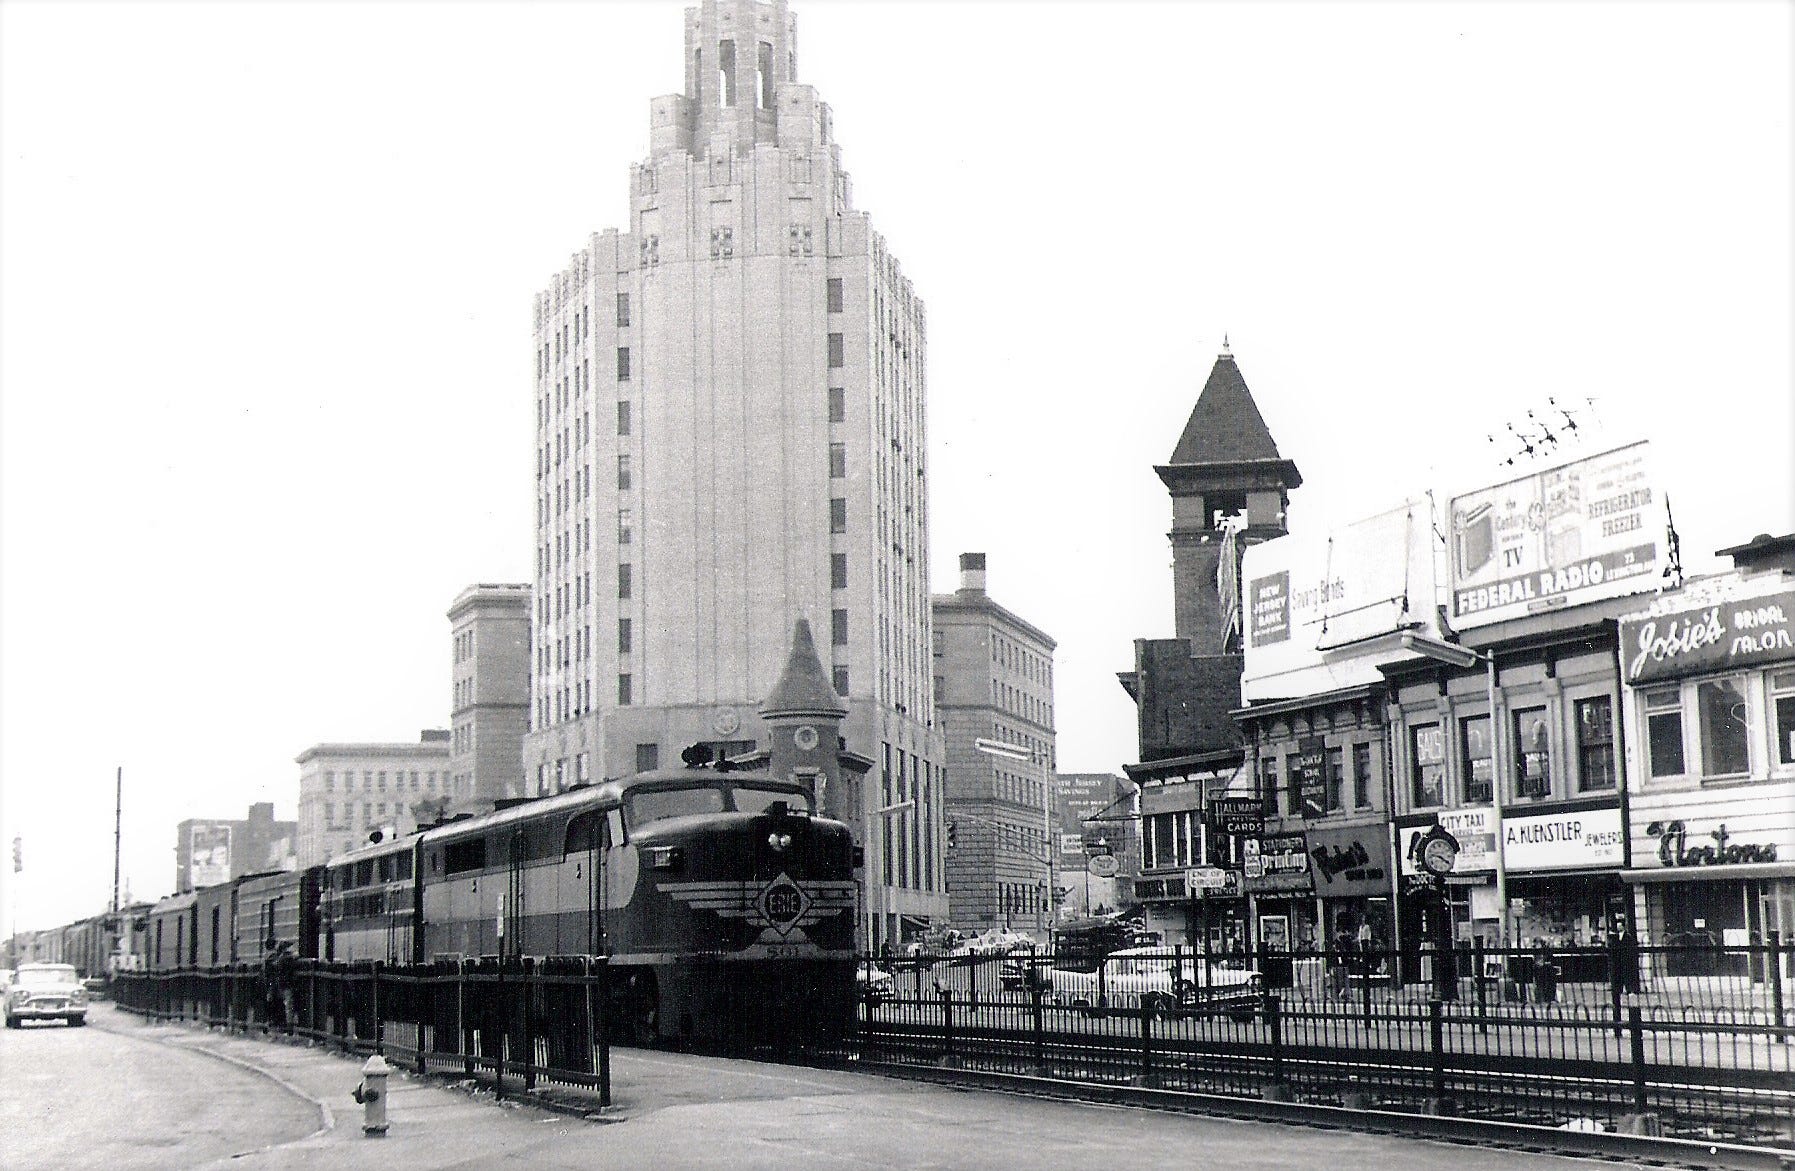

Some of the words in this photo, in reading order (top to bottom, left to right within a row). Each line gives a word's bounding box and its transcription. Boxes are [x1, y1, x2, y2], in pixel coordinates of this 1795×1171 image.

[1602, 512, 1643, 537] FREEZER
[1503, 545, 1523, 568] TV
[1458, 578, 1536, 616] FEDERAL
[1540, 560, 1604, 596] RADIO
[1734, 605, 1788, 630] BRIDAL
[1630, 607, 1726, 679] Josie's
[1227, 822, 1263, 832] CARDS
[1440, 815, 1461, 830] CITY
[1464, 813, 1484, 828] TAXI
[1584, 831, 1624, 847] JEWELERS
[769, 894, 799, 913] ERIE
